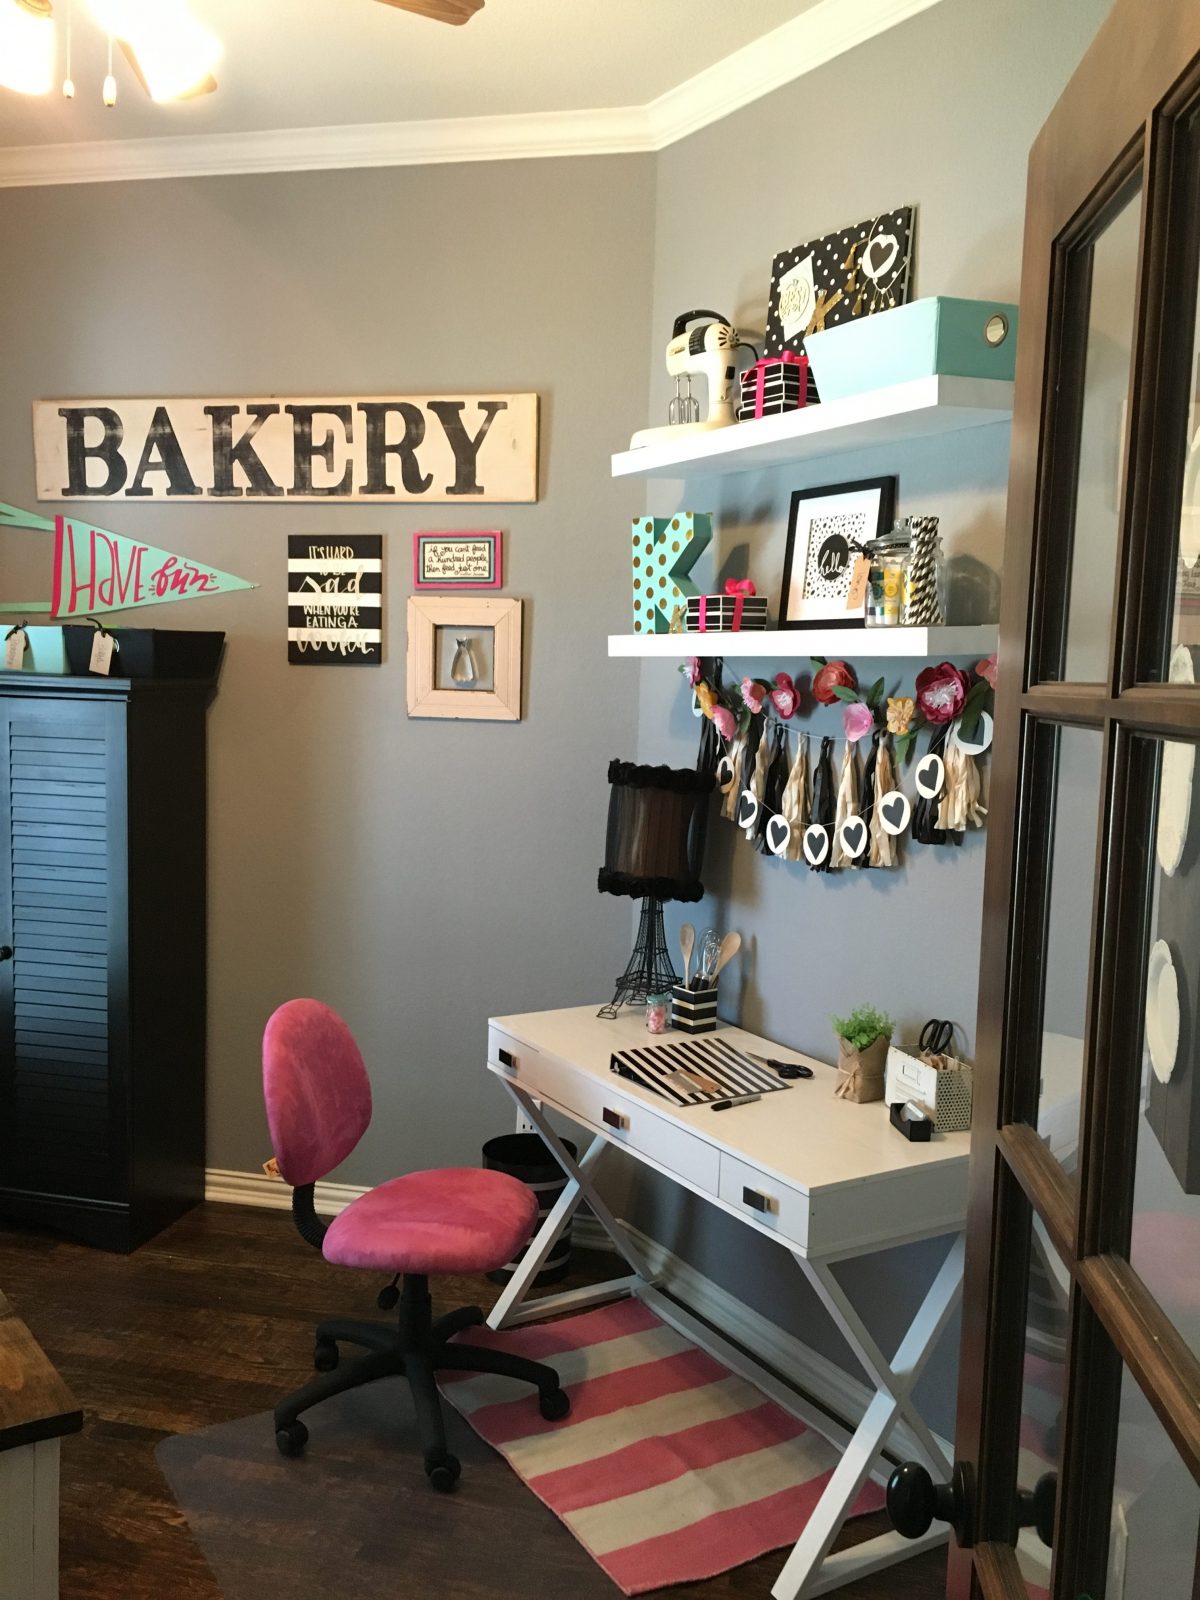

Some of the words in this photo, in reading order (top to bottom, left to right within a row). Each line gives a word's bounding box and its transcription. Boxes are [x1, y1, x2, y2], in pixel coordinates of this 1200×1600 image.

[58, 401, 508, 497] BAKERY
[428, 545, 438, 557] if
[440, 545, 453, 557] you
[436, 554, 465, 563] hundred
[426, 564, 440, 573] then
[454, 563, 472, 575] just
[818, 550, 847, 576] hello
[151, 556, 220, 597] fun
[297, 564, 364, 601] sad
[631, 512, 704, 635] K
[303, 604, 331, 616] WHEN
[306, 616, 346, 629] EATING
[348, 616, 359, 628] A
